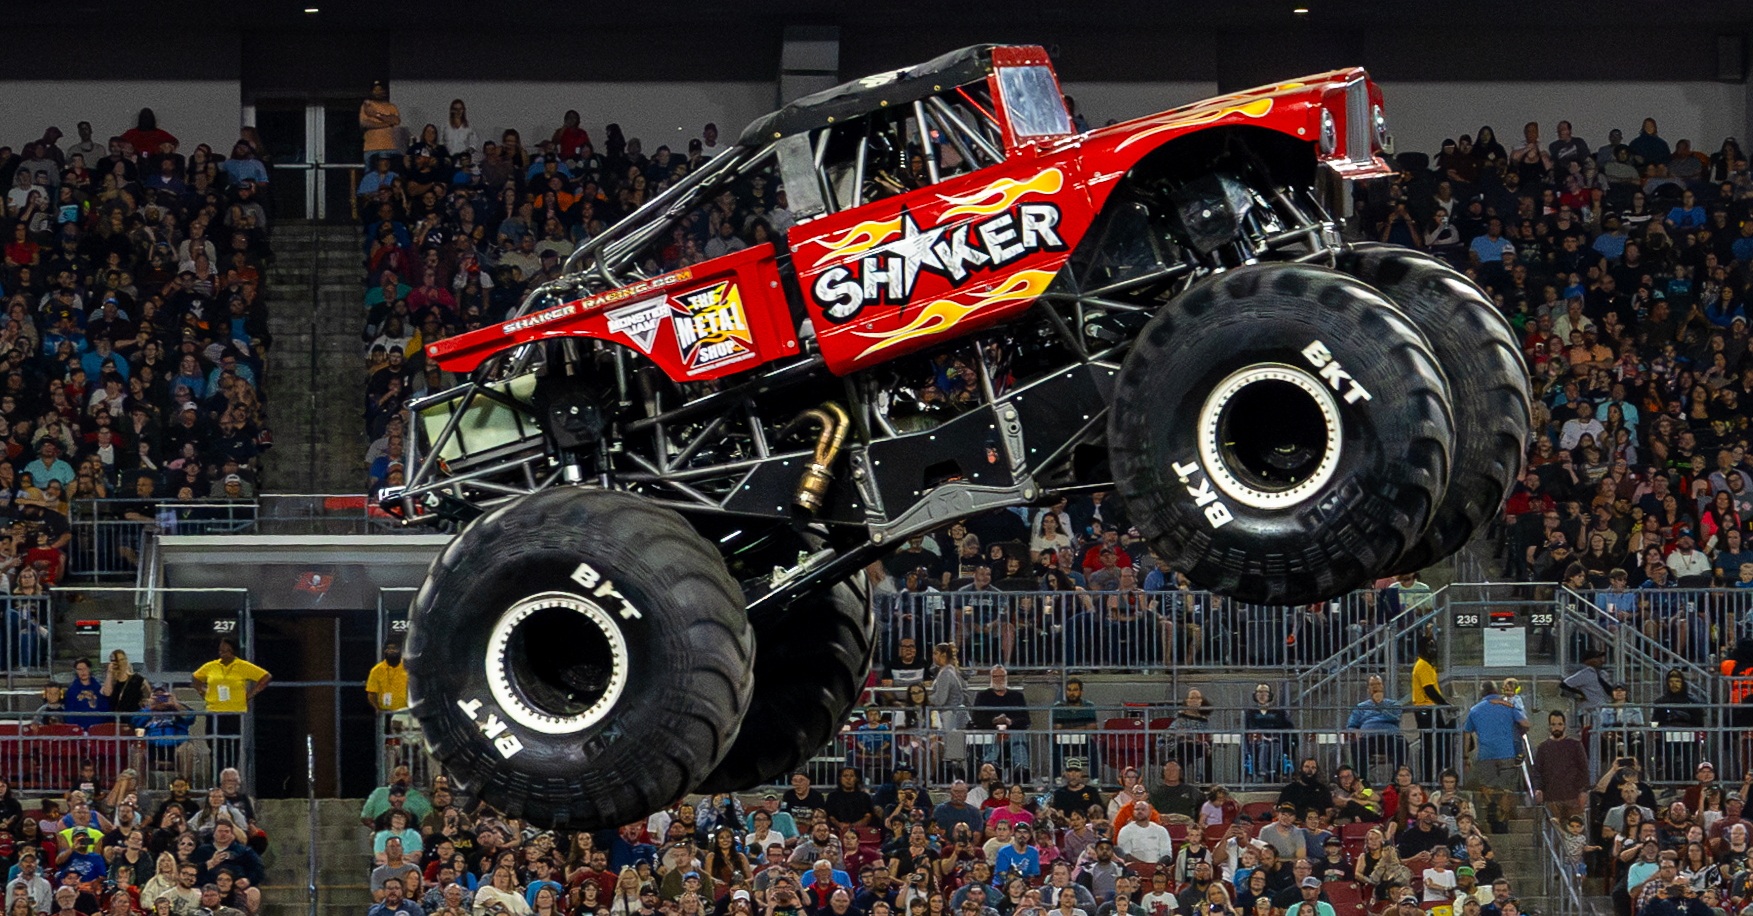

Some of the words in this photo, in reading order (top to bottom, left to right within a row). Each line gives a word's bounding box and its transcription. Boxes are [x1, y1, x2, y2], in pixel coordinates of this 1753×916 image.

[687, 290, 716, 310] THE
[502, 305, 576, 334] SHAKER
[607, 303, 671, 334] MONSTER
[630, 319, 656, 335] JAM
[674, 301, 747, 349] METAL
[699, 340, 736, 362] SHOP
[1301, 340, 1373, 404] BKT
[1172, 461, 1234, 528] BKT
[213, 620, 236, 630] 237
[1456, 615, 1478, 624] 236
[1531, 614, 1552, 623] 235
[457, 698, 523, 759] BKT
